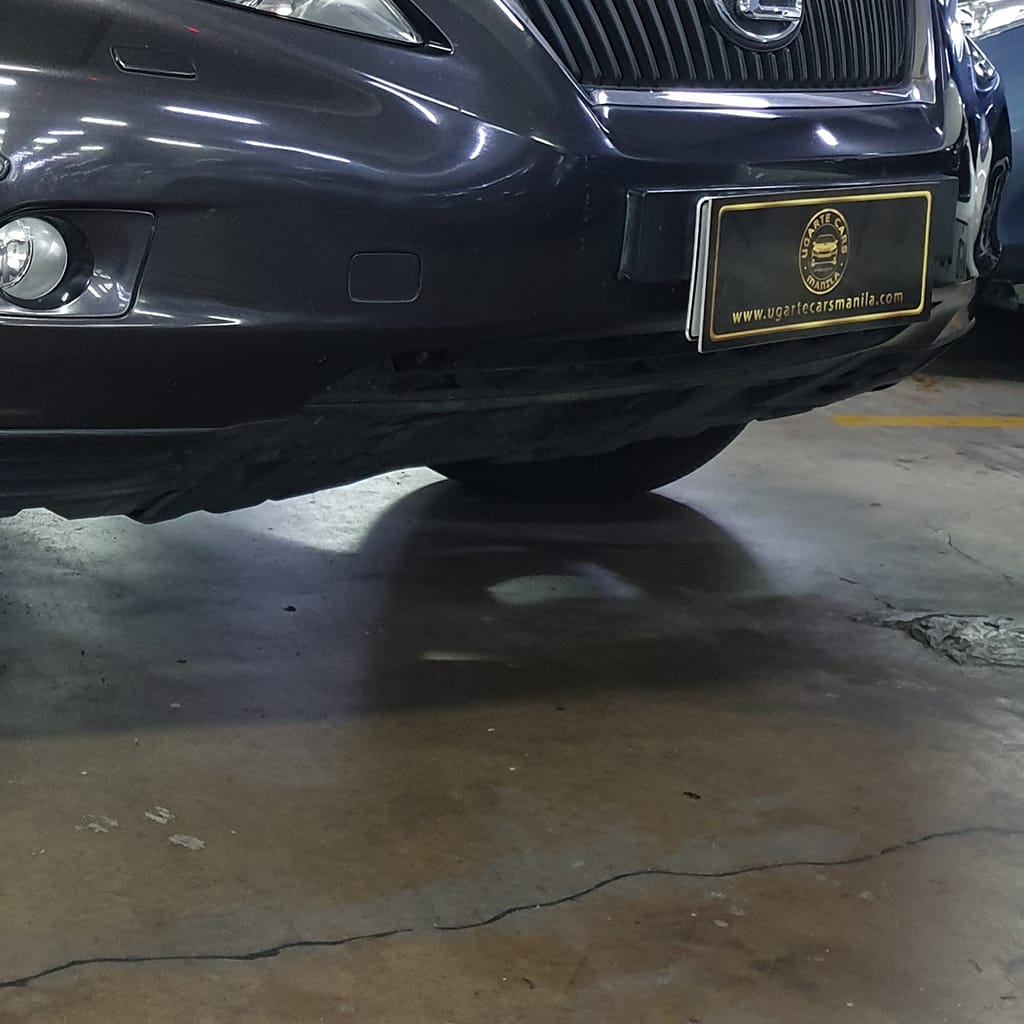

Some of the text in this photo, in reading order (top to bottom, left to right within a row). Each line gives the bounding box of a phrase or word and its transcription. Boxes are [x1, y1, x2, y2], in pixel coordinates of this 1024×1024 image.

[801, 213, 832, 259] UGARTE
[806, 271, 841, 291] MANILA
[732, 290, 904, 324] www.ugartecarsmanila.com
